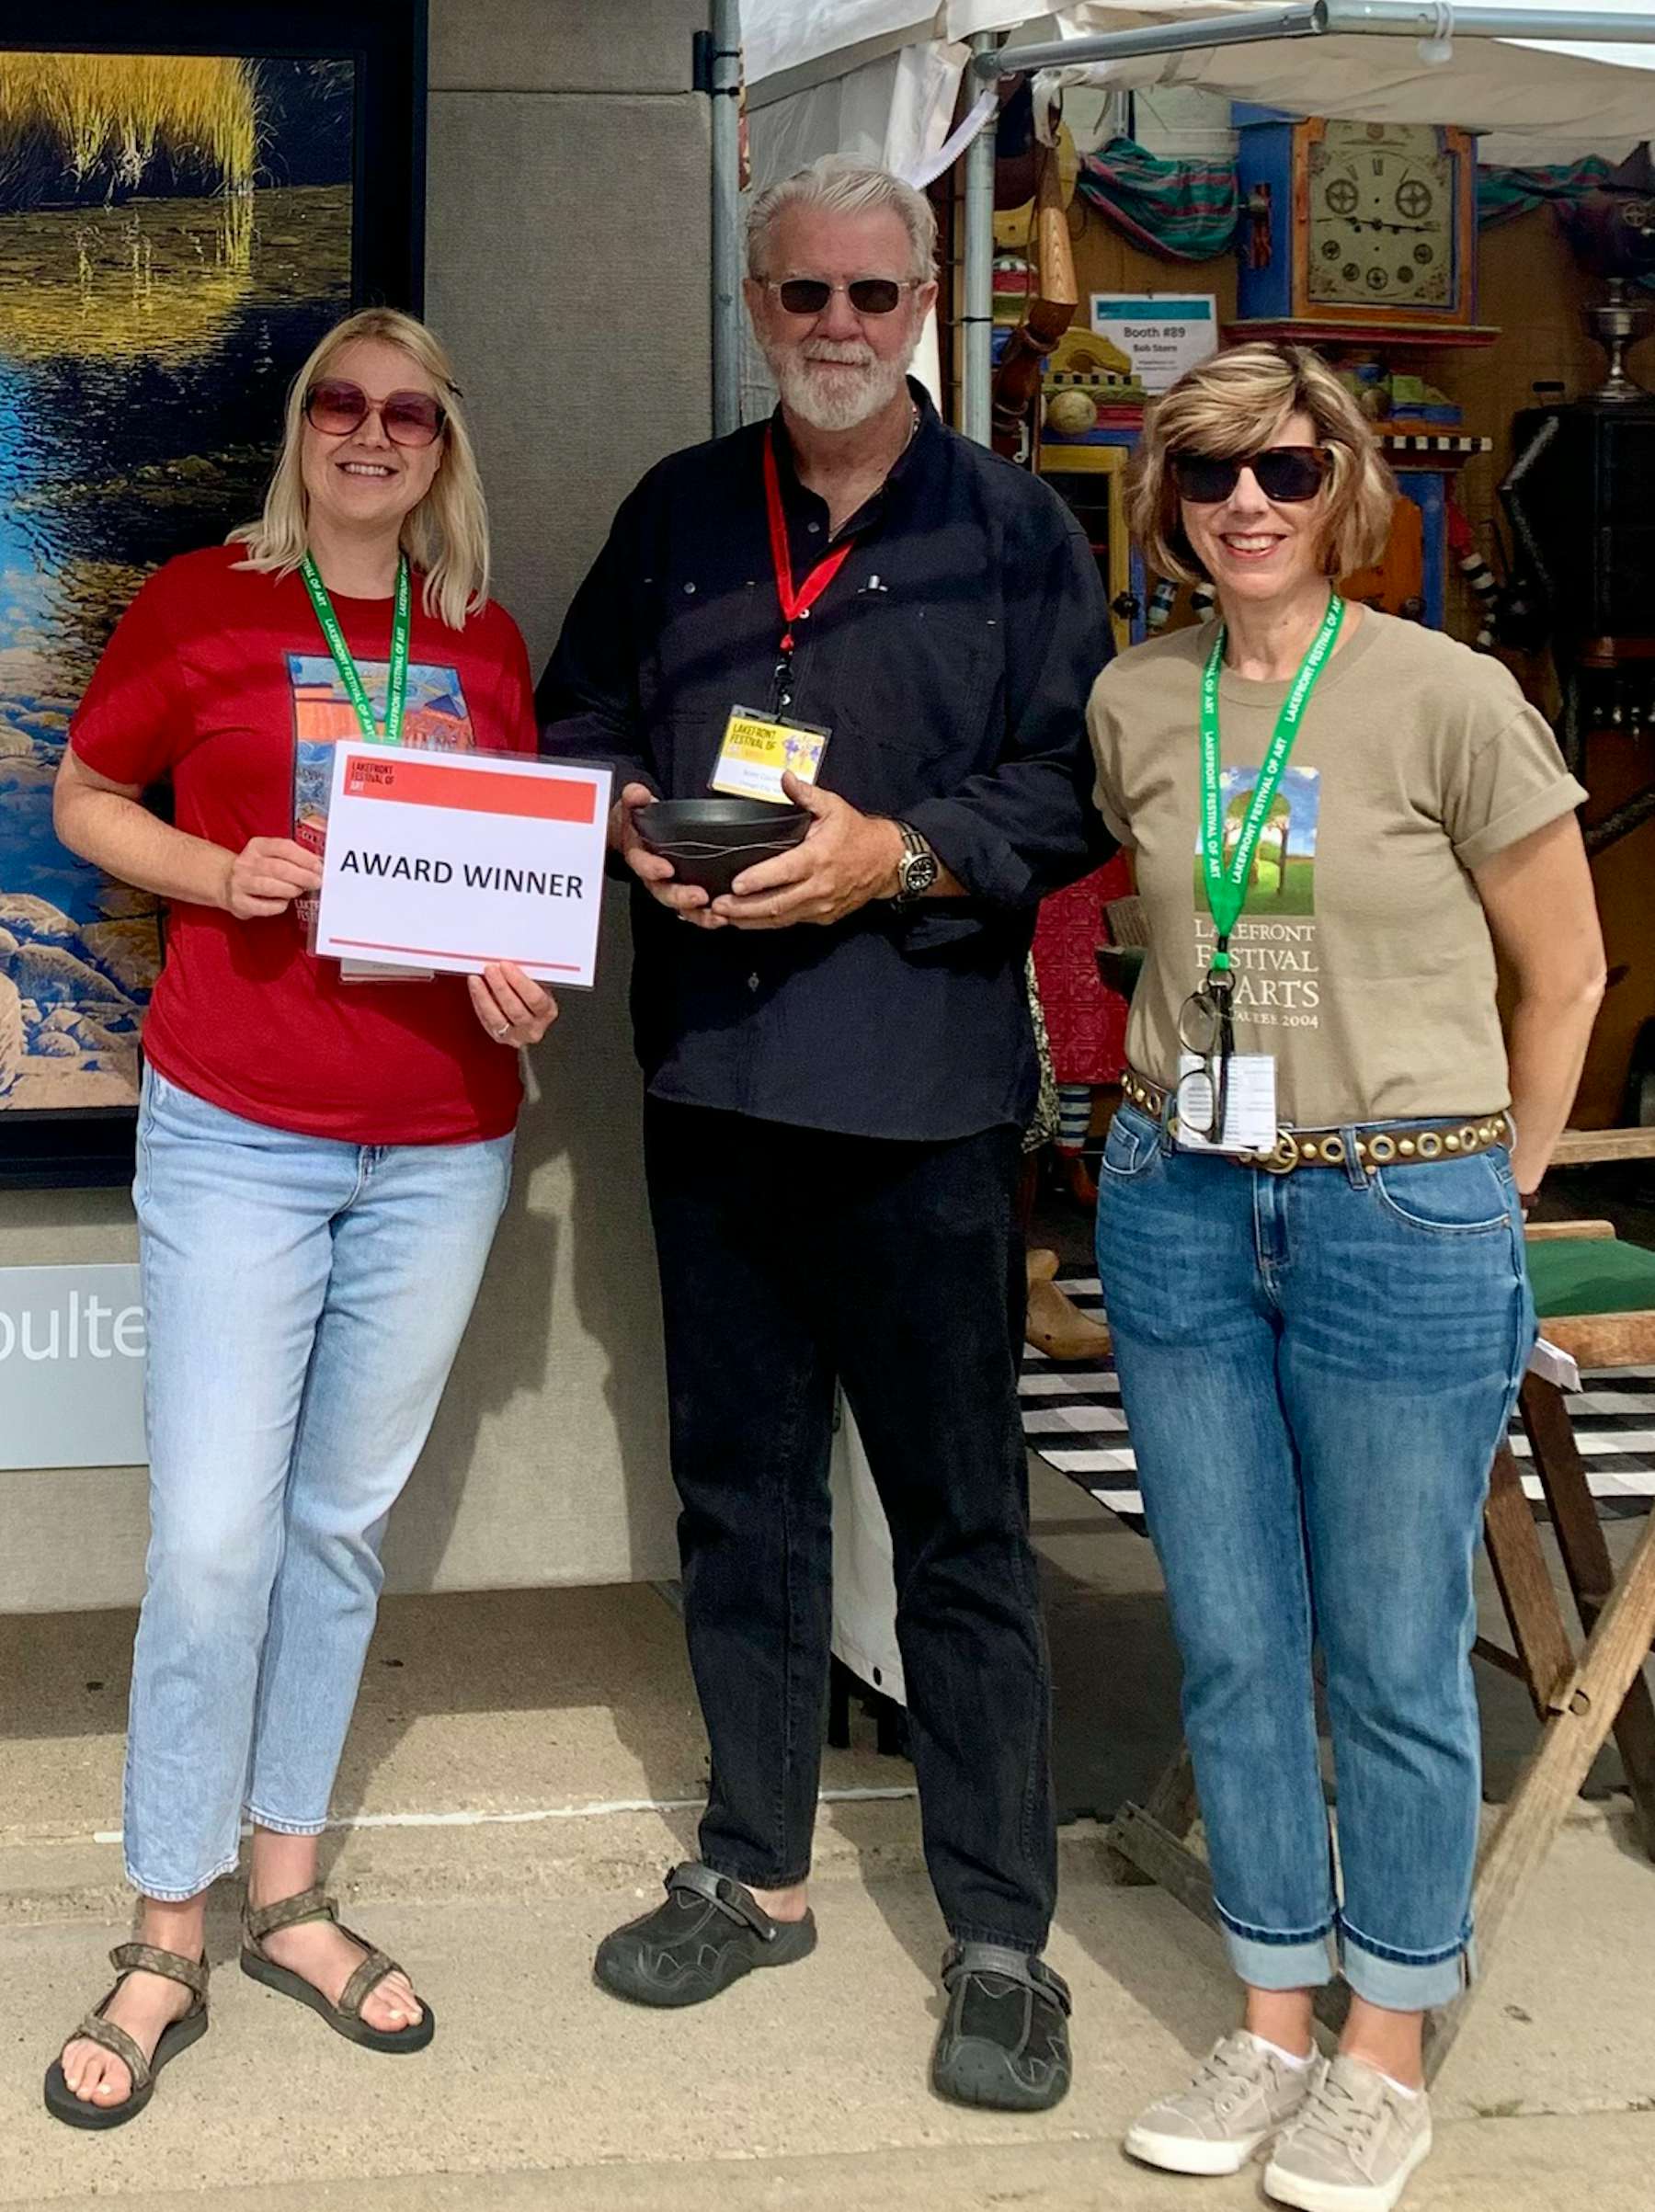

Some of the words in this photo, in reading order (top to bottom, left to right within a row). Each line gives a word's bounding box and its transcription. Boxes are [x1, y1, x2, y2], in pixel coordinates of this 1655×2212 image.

[1124, 326, 1160, 338] Booth
[1162, 326, 1187, 338] #89
[314, 590, 327, 607] ART
[325, 618, 349, 666] LAKEFRONT
[394, 656, 404, 690] FESTIVAL
[1284, 665, 1316, 724] LAKEFRONT
[1307, 627, 1334, 667] FESTIVAL
[1326, 614, 1338, 627] OF
[343, 667, 364, 704] FESTIVAL
[1204, 679, 1215, 693] OF
[358, 703, 370, 716] OF
[389, 691, 401, 740] LAKEFRONT
[1204, 696, 1215, 714] ART
[362, 715, 376, 736] ART
[733, 724, 776, 738] LAKEFRONT
[730, 734, 763, 749] FESTIVAL
[765, 741, 776, 750] OF
[351, 761, 394, 775] LAKEFRONT
[1205, 731, 1216, 790] LAKEFRONT
[350, 770, 384, 784] FESTIVAL
[384, 775, 395, 785] OF
[1206, 792, 1217, 838] FESTIVAL
[1231, 822, 1257, 884] LAKEFRONT
[1250, 776, 1275, 822] FESTIVAL
[1267, 758, 1279, 775] OF
[1273, 737, 1287, 759] ART
[1207, 840, 1219, 857] OF
[339, 850, 453, 884] AWARD
[463, 863, 584, 899] WINNER
[1209, 858, 1222, 879] ART
[1193, 918, 1316, 941] LAEFRONT
[1194, 944, 1320, 973] FSTIVAL
[1234, 975, 1320, 1009] ARTS
[1282, 1014, 1319, 1029] 2004
